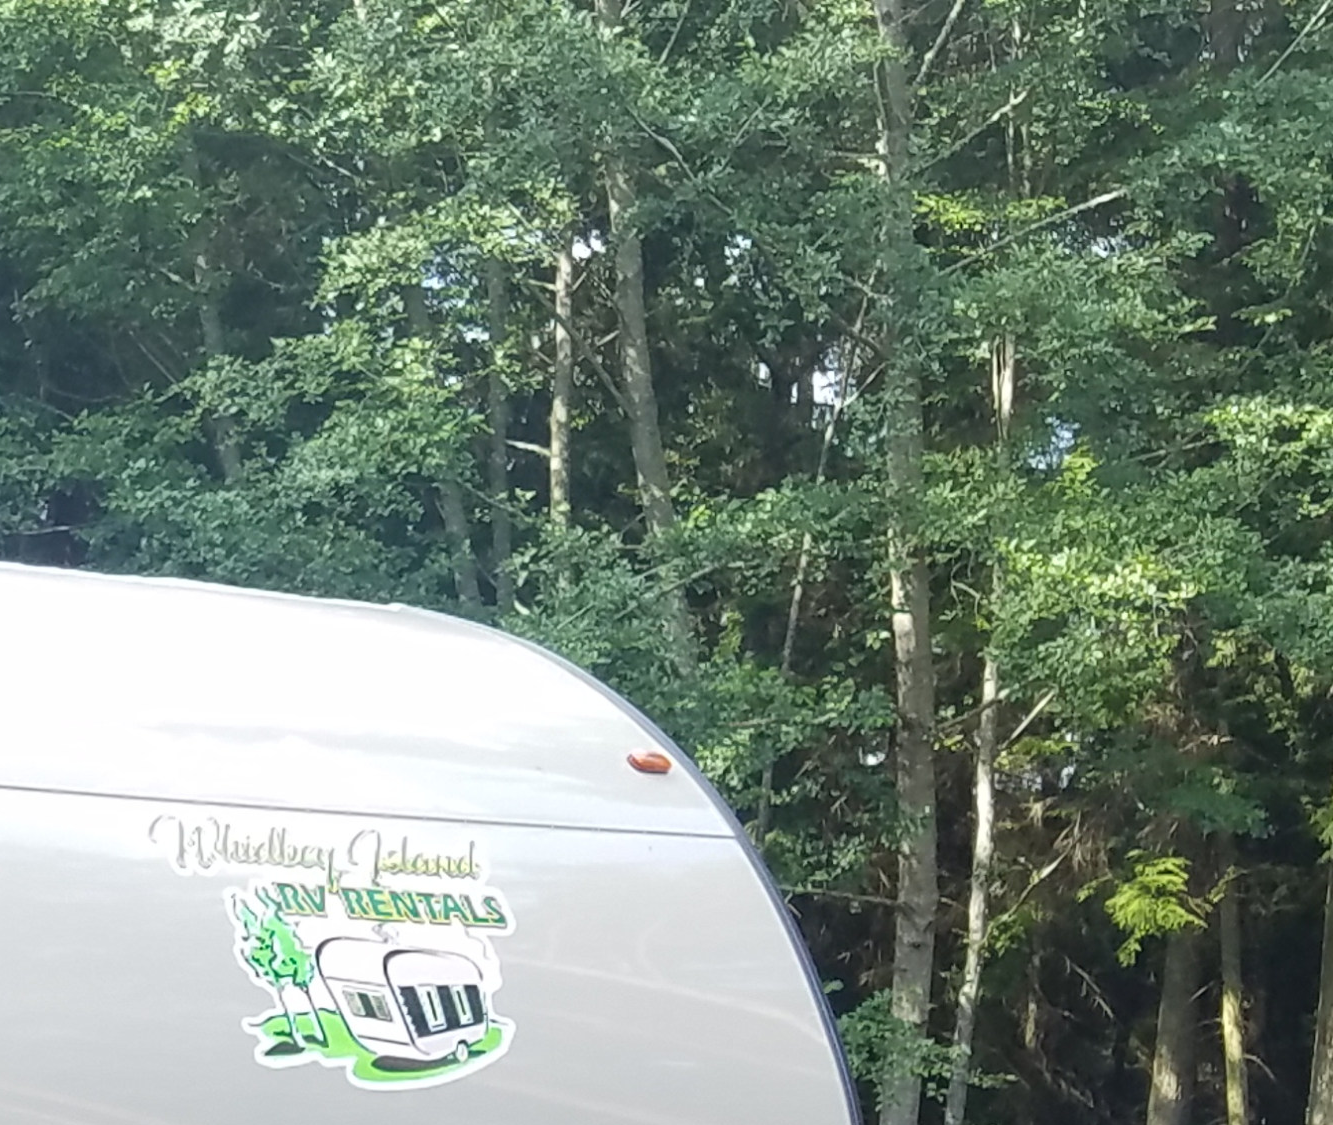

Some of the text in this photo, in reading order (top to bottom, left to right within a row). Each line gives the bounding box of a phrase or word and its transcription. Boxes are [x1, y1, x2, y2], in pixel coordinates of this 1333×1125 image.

[348, 829, 481, 887] Island
[275, 881, 508, 930] RV RENTALS
